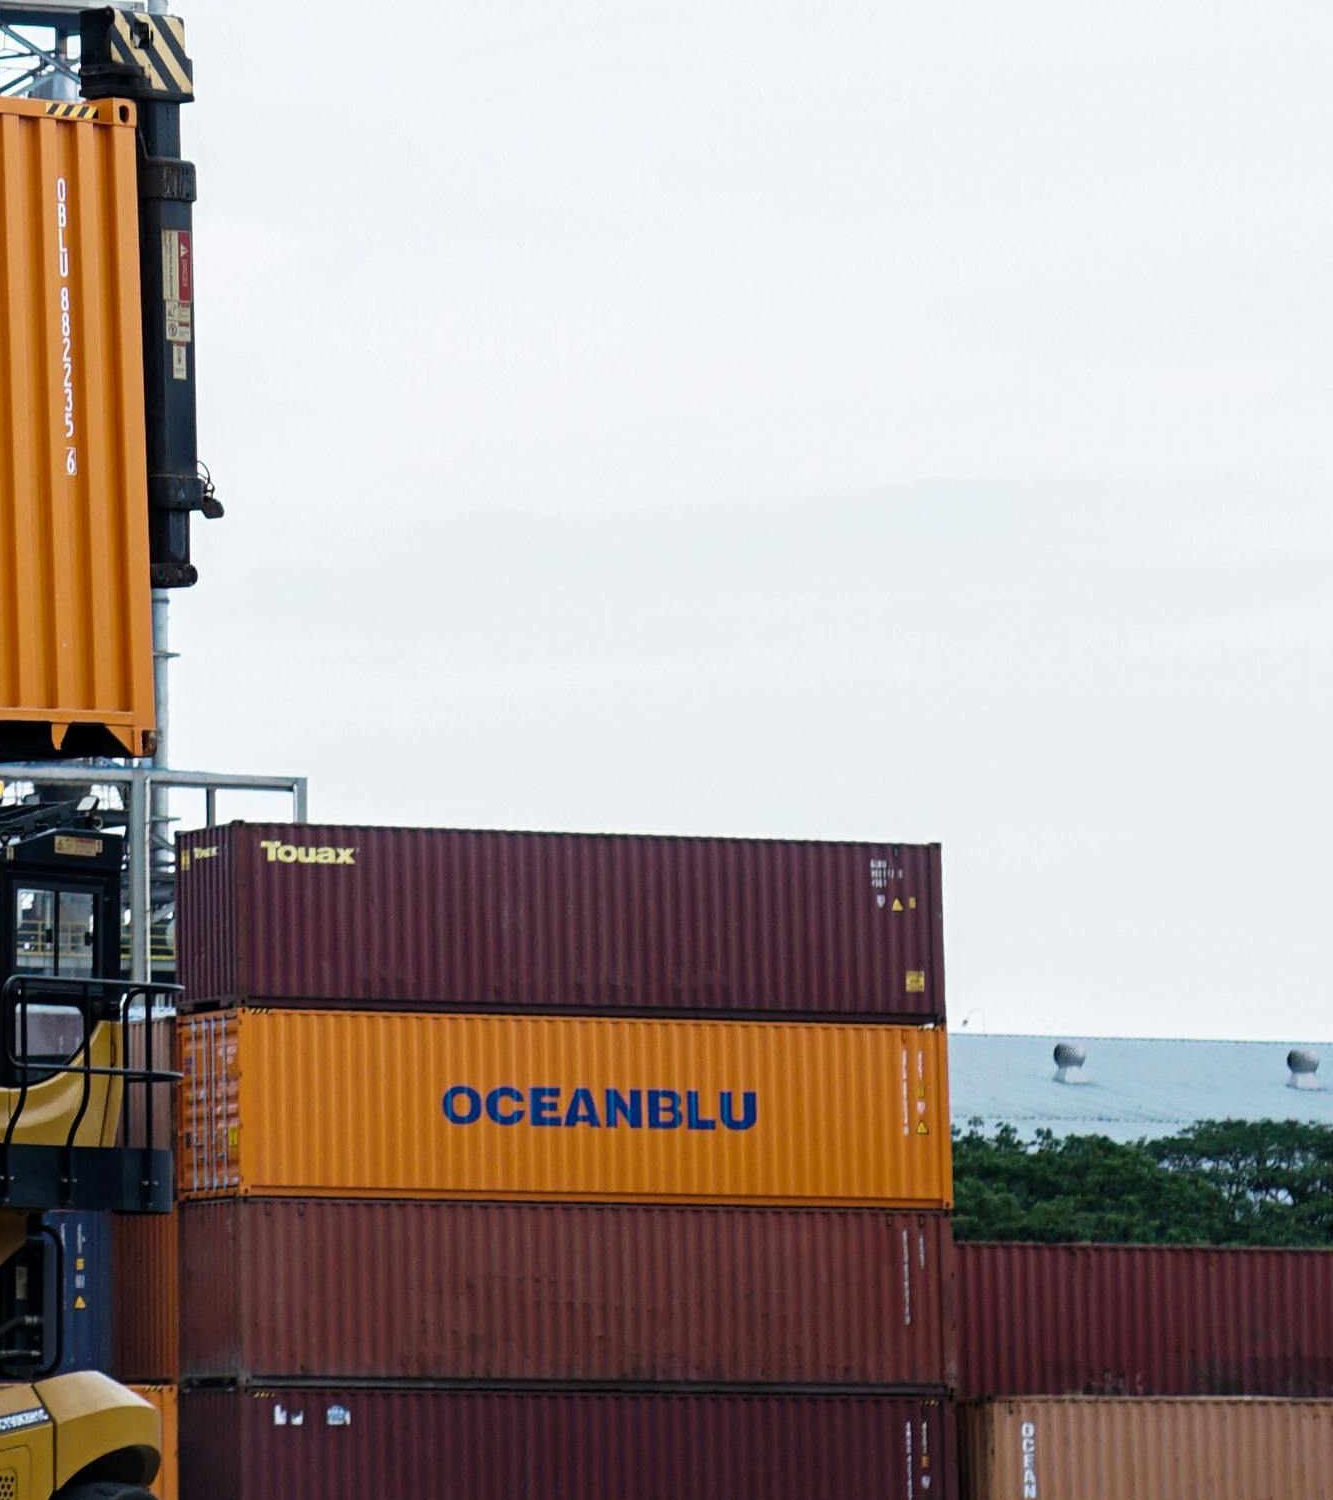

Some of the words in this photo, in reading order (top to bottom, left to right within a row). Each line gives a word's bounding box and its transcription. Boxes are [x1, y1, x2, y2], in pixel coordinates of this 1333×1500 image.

[56, 177, 69, 278] OBLU
[60, 286, 74, 438] 882235
[66, 449, 76, 475] 6
[260, 840, 357, 865] Touax
[442, 1085, 758, 1131] OCEANBLU
